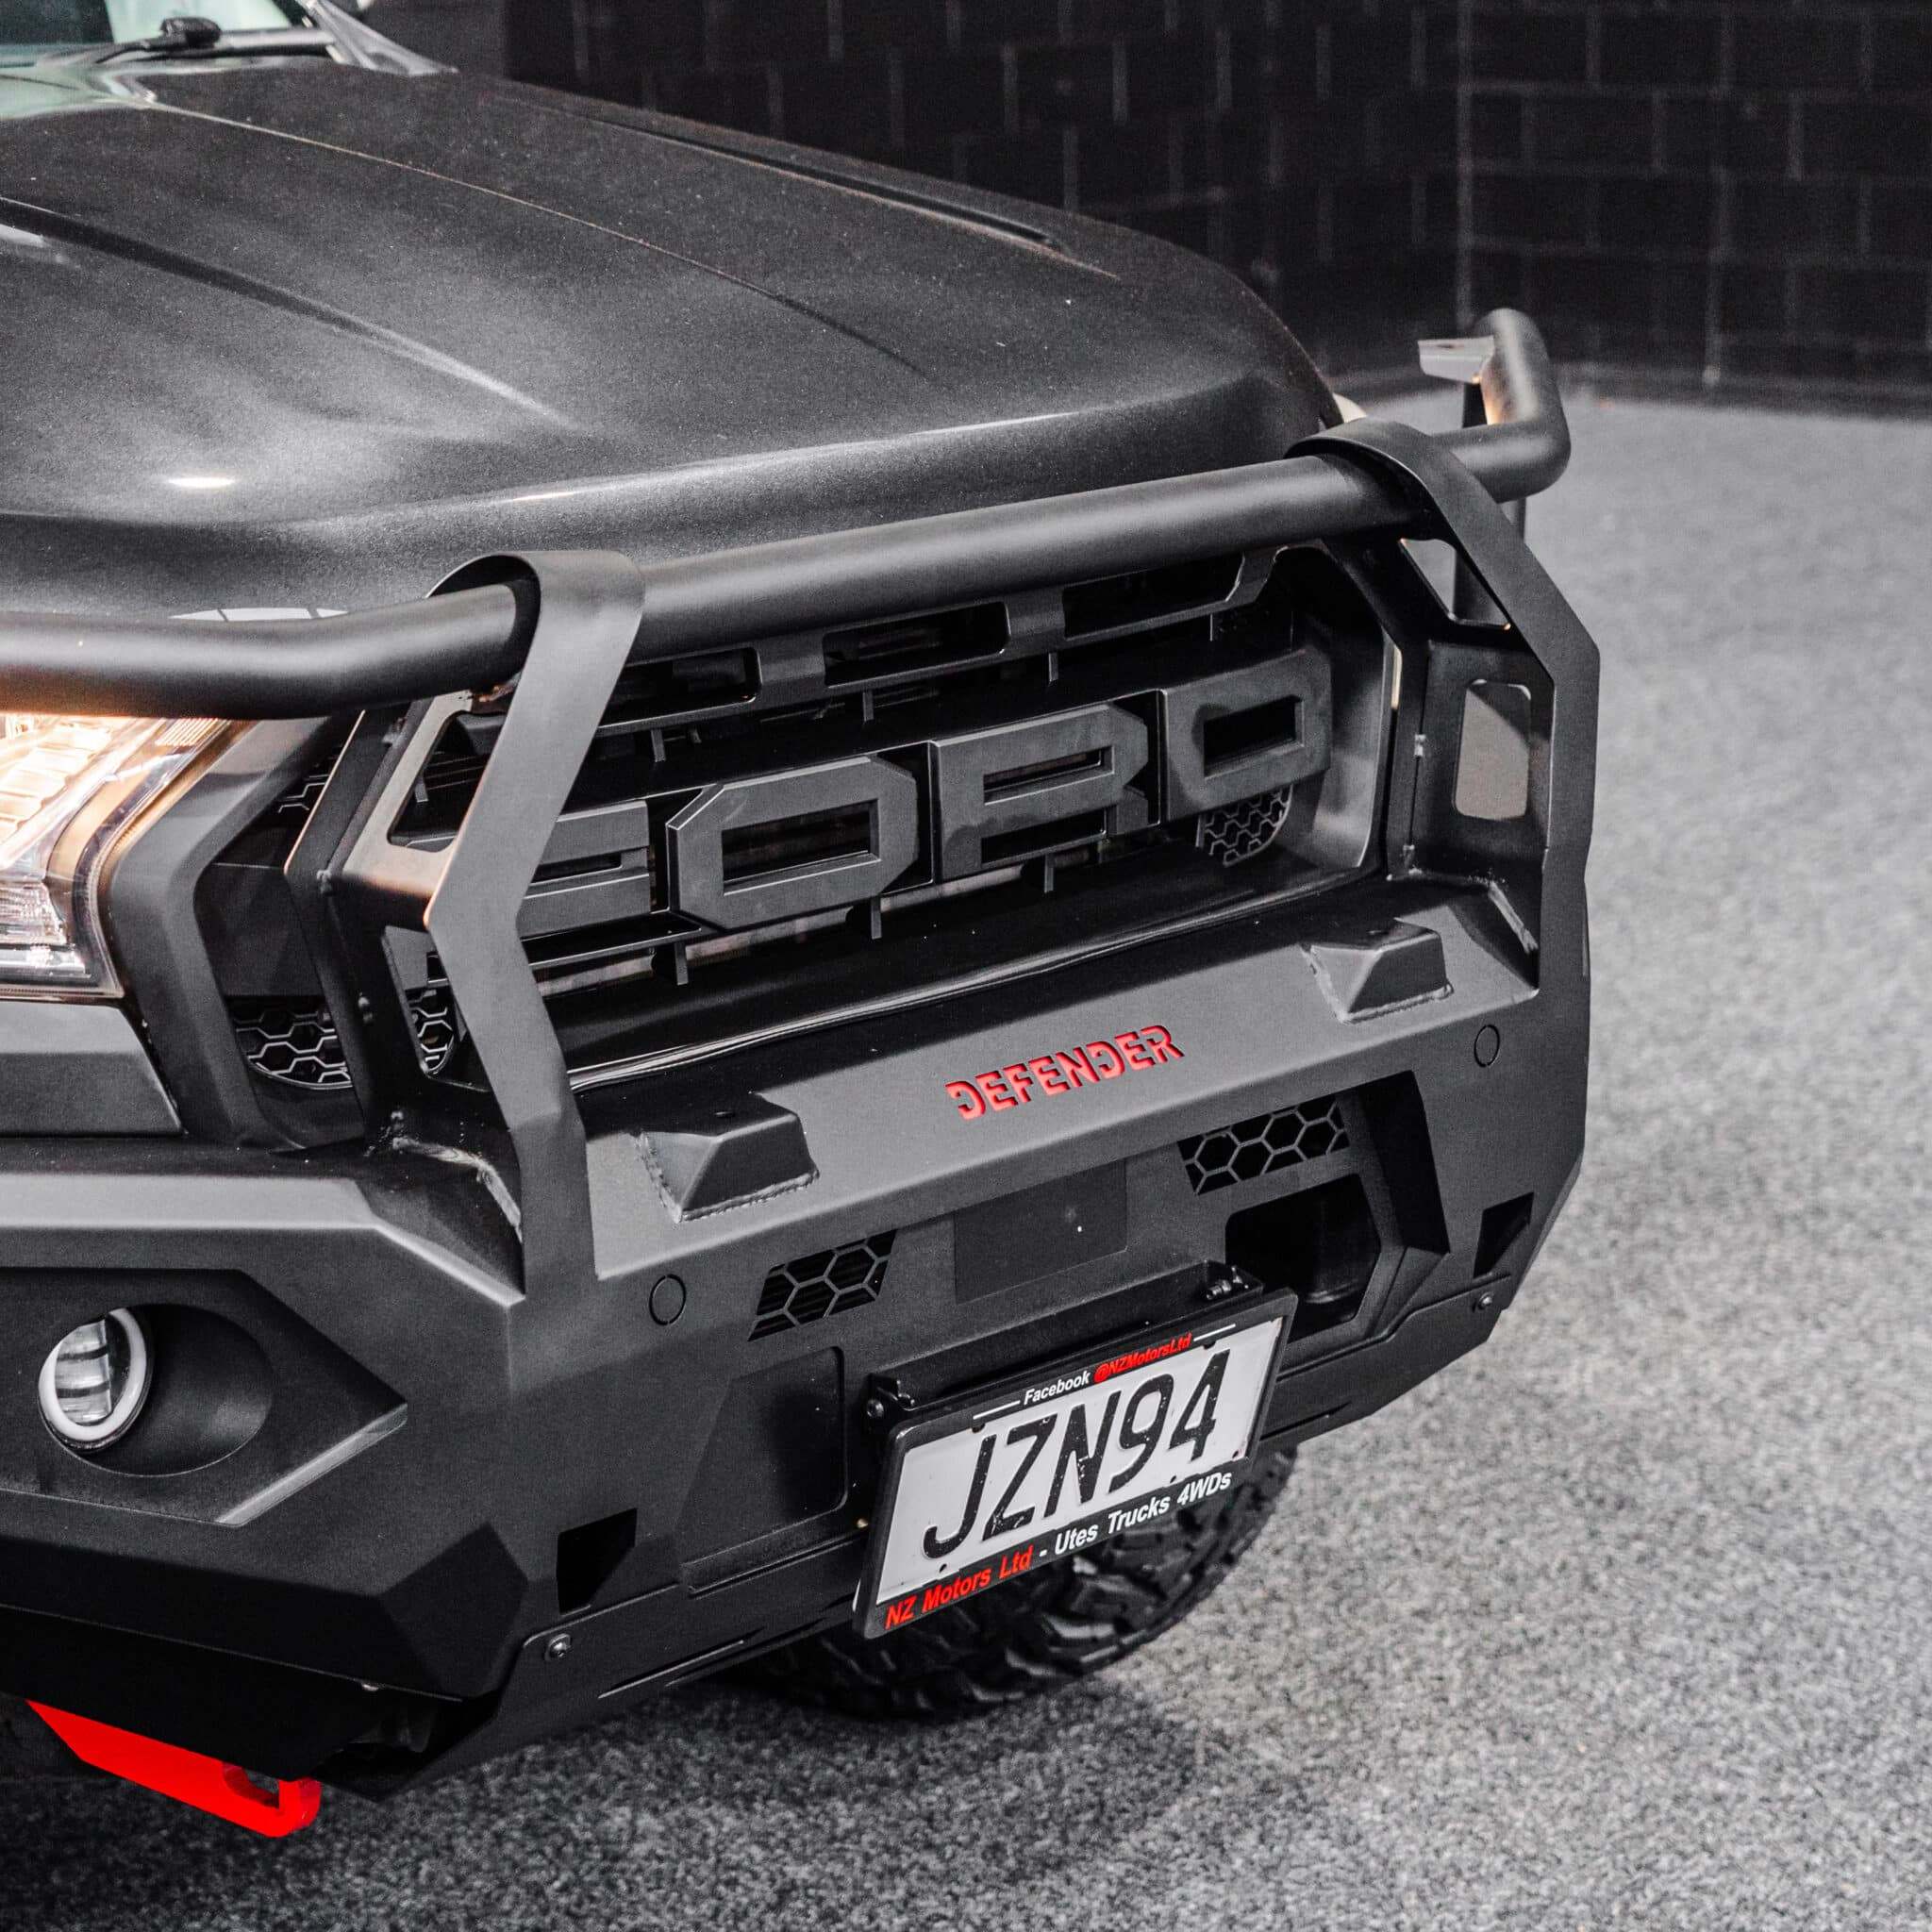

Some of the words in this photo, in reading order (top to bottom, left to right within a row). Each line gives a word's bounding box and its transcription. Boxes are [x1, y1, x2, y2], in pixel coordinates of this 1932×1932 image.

[944, 1024, 1185, 1121] DEFENDER
[1023, 1371, 1091, 1406] Facebook
[1093, 1332, 1193, 1384] @NZMotorsLtd
[923, 1348, 1231, 1558] JZN94
[884, 1594, 918, 1630] NZ
[921, 1567, 992, 1614] Motors
[998, 1544, 1034, 1580] Ltd
[1055, 1524, 1099, 1556] Utes
[1108, 1496, 1171, 1534] Trucks
[1176, 1472, 1233, 1506] 4WDs
